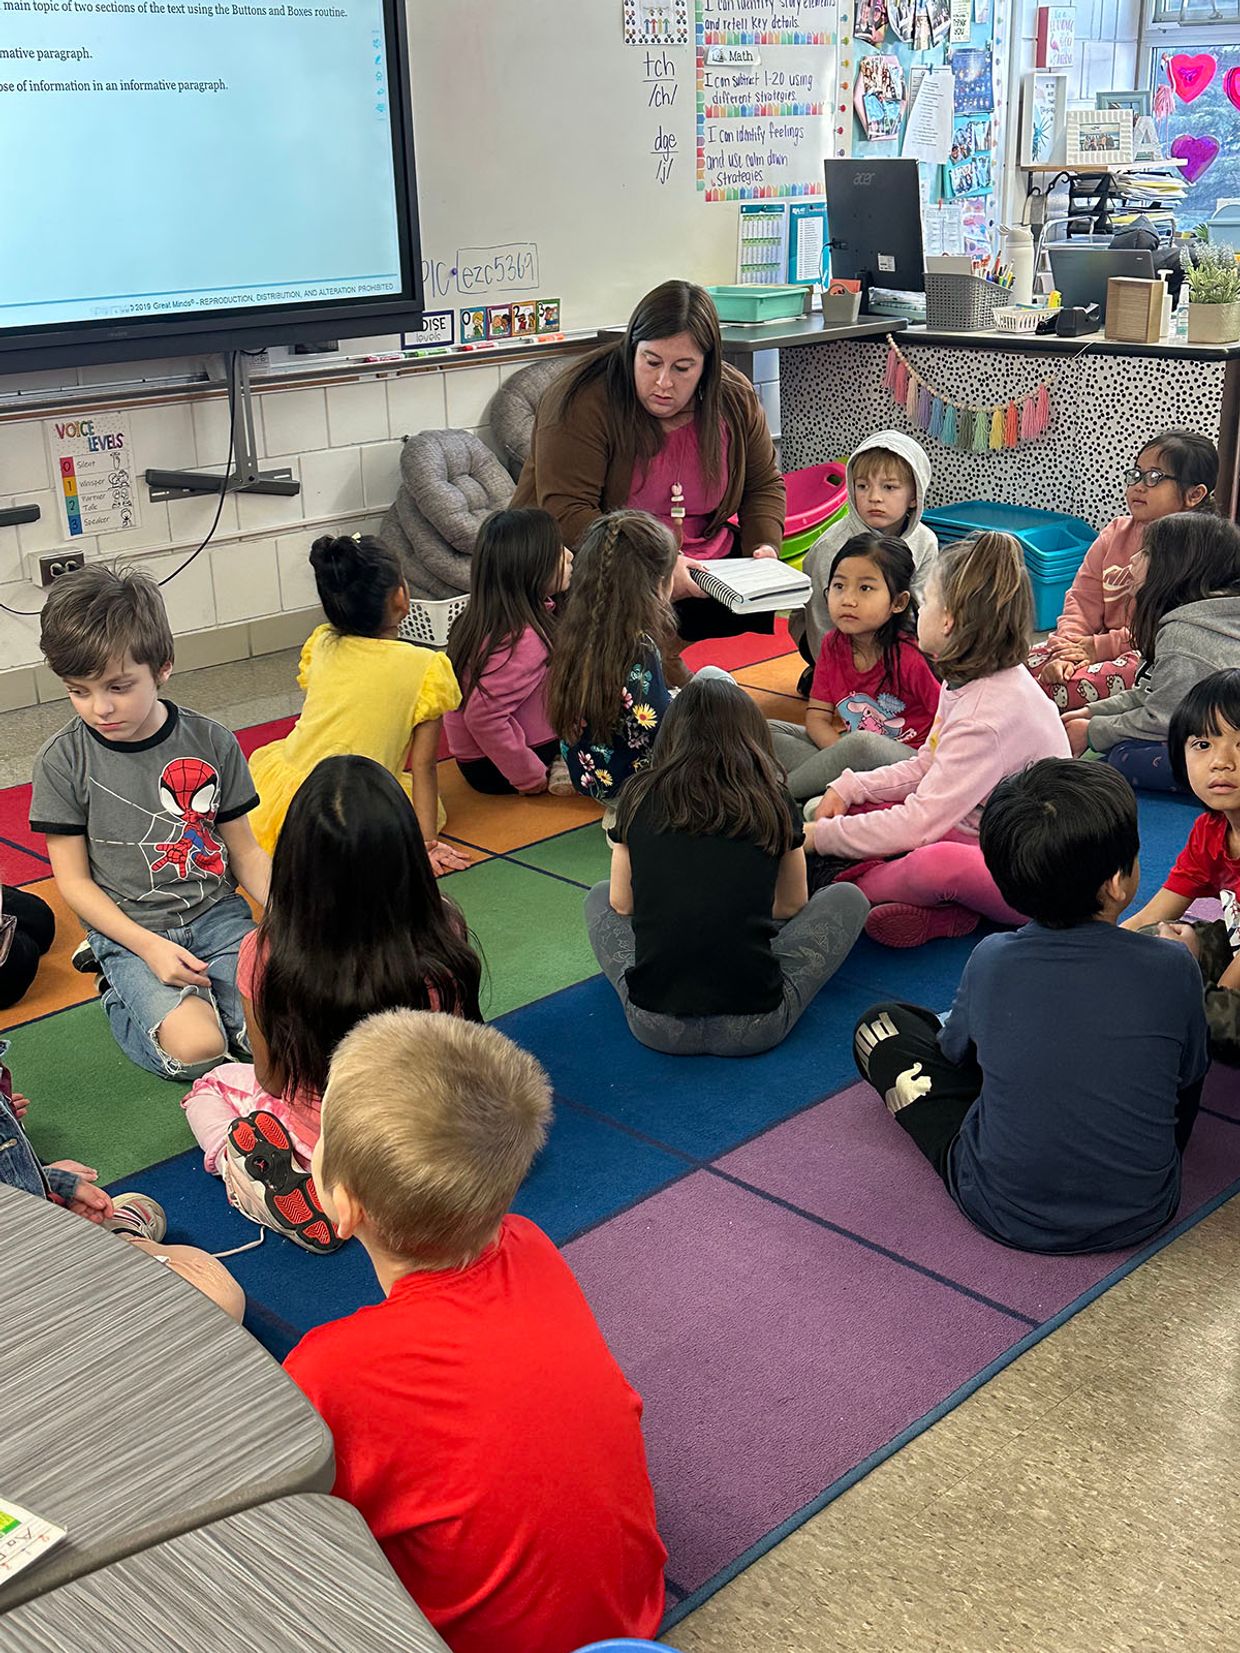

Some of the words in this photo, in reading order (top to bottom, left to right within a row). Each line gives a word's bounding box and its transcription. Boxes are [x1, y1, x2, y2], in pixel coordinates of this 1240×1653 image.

[3, 1, 31, 11] main
[32, 1, 59, 14] topic
[61, 1, 73, 12] of
[74, 2, 93, 12] two
[95, 2, 135, 13] sections
[137, 2, 149, 14] of
[150, 2, 165, 14] the
[167, 4, 185, 14] text
[187, 4, 213, 17] using
[215, 4, 230, 15] the
[231, 5, 267, 16] Buttons
[268, 5, 286, 16] and
[287, 6, 313, 17] Boxes
[314, 6, 348, 18] routine.
[705, 0, 714, 11] I
[717, 0, 734, 11] can
[704, 18, 720, 30] and
[723, 17, 748, 30] retell
[0, 46, 35, 59] mative
[36, 47, 93, 62] paragraph.
[729, 50, 754, 62] Math
[642, 51, 675, 77] tch
[16, 79, 28, 92] of
[28, 79, 91, 92] information
[93, 80, 103, 91] in
[105, 81, 118, 91] an
[120, 79, 177, 91] informative
[177, 78, 229, 93] paragraph.
[704, 72, 713, 88] I
[714, 76, 730, 88] can
[764, 70, 785, 87] 1-20
[789, 73, 813, 91] using
[648, 84, 678, 107] /ch/
[712, 91, 752, 105] different
[707, 125, 717, 143] I
[719, 129, 734, 143] can
[736, 125, 766, 145] identify
[769, 121, 804, 146] feelings
[654, 125, 677, 162] dge
[706, 149, 724, 170] and
[728, 152, 742, 169] use
[745, 152, 764, 168] calm
[767, 149, 788, 166] down
[853, 171, 876, 185] acer
[152, 301, 172, 310] Great
[304, 290, 318, 298] AND
[319, 286, 356, 296] ALTERATION
[357, 282, 394, 293] PROHIBITED
[488, 309, 492, 324] 1
[513, 305, 520, 318] 2
[538, 302, 545, 317] 3
[421, 317, 446, 331] OISE
[461, 311, 471, 326] 0
[416, 332, 442, 343] levels
[55, 420, 95, 439] VOICE
[88, 432, 125, 452] LEVELS
[62, 461, 71, 472] 0
[67, 480, 73, 492] 1
[68, 499, 76, 511] 2
[70, 518, 79, 530] 3
